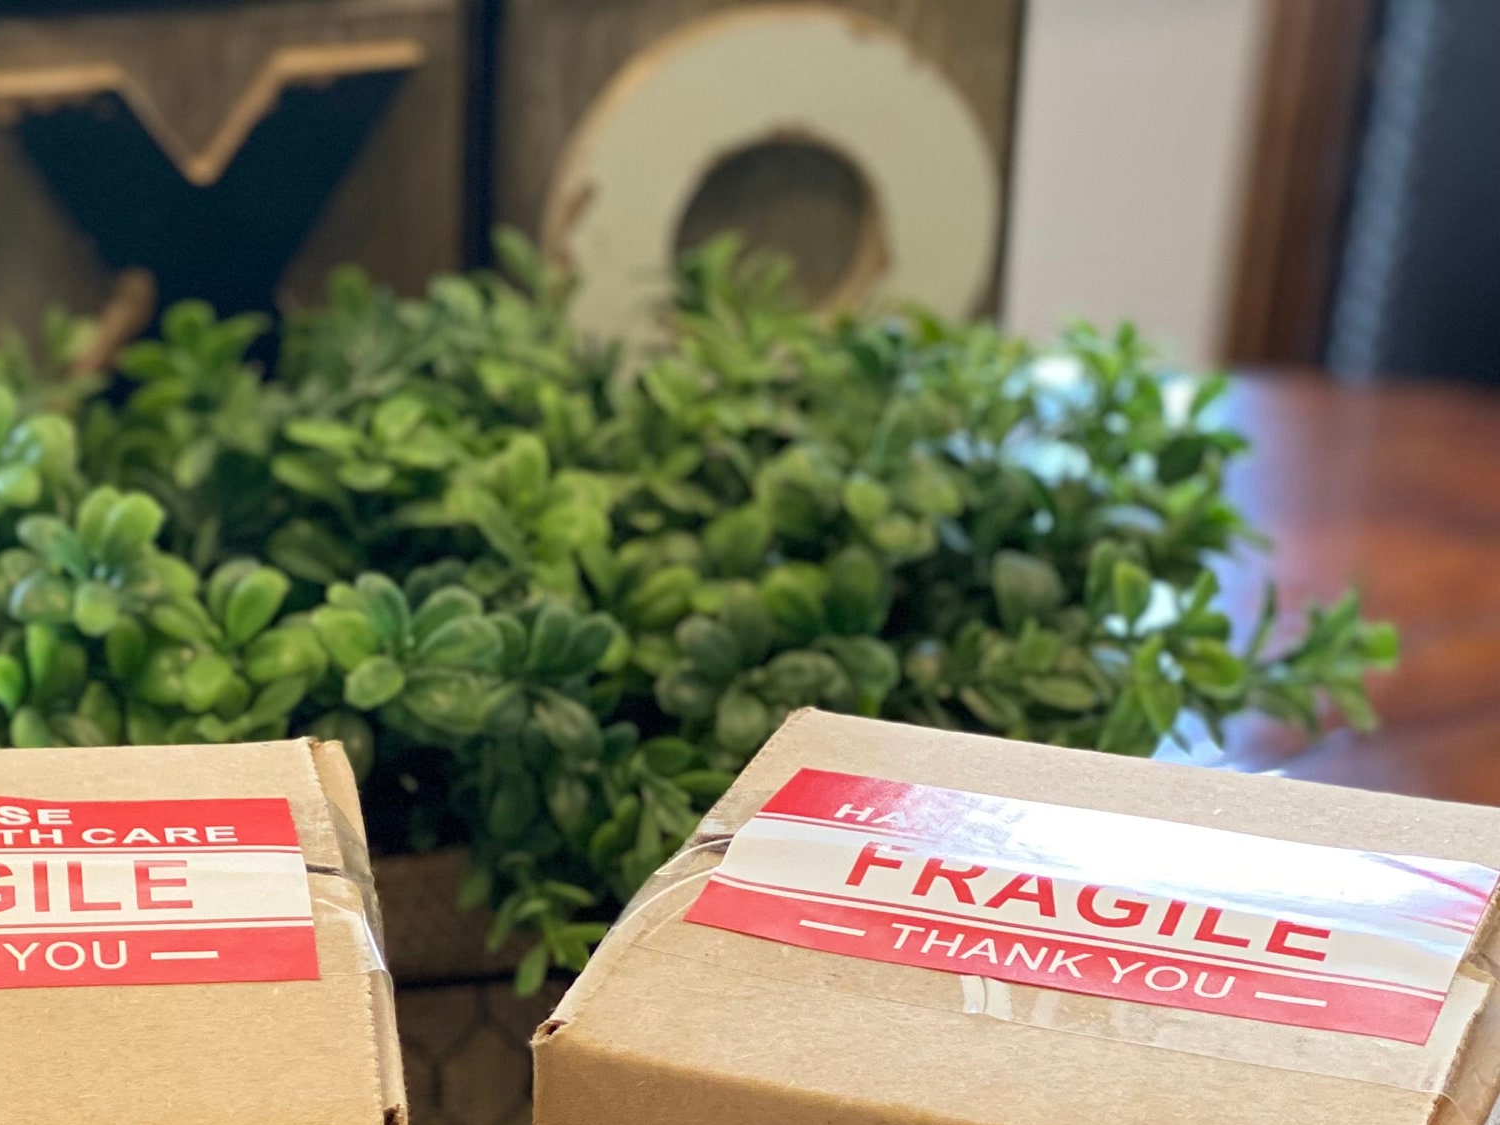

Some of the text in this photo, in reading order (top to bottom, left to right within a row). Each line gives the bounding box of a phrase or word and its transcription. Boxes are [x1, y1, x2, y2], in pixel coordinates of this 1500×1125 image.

[81, 825, 238, 845] CARE
[844, 840, 1332, 962] FRAGILE
[2, 939, 129, 972] YOU
[889, 921, 1237, 1000] THANK YOU
